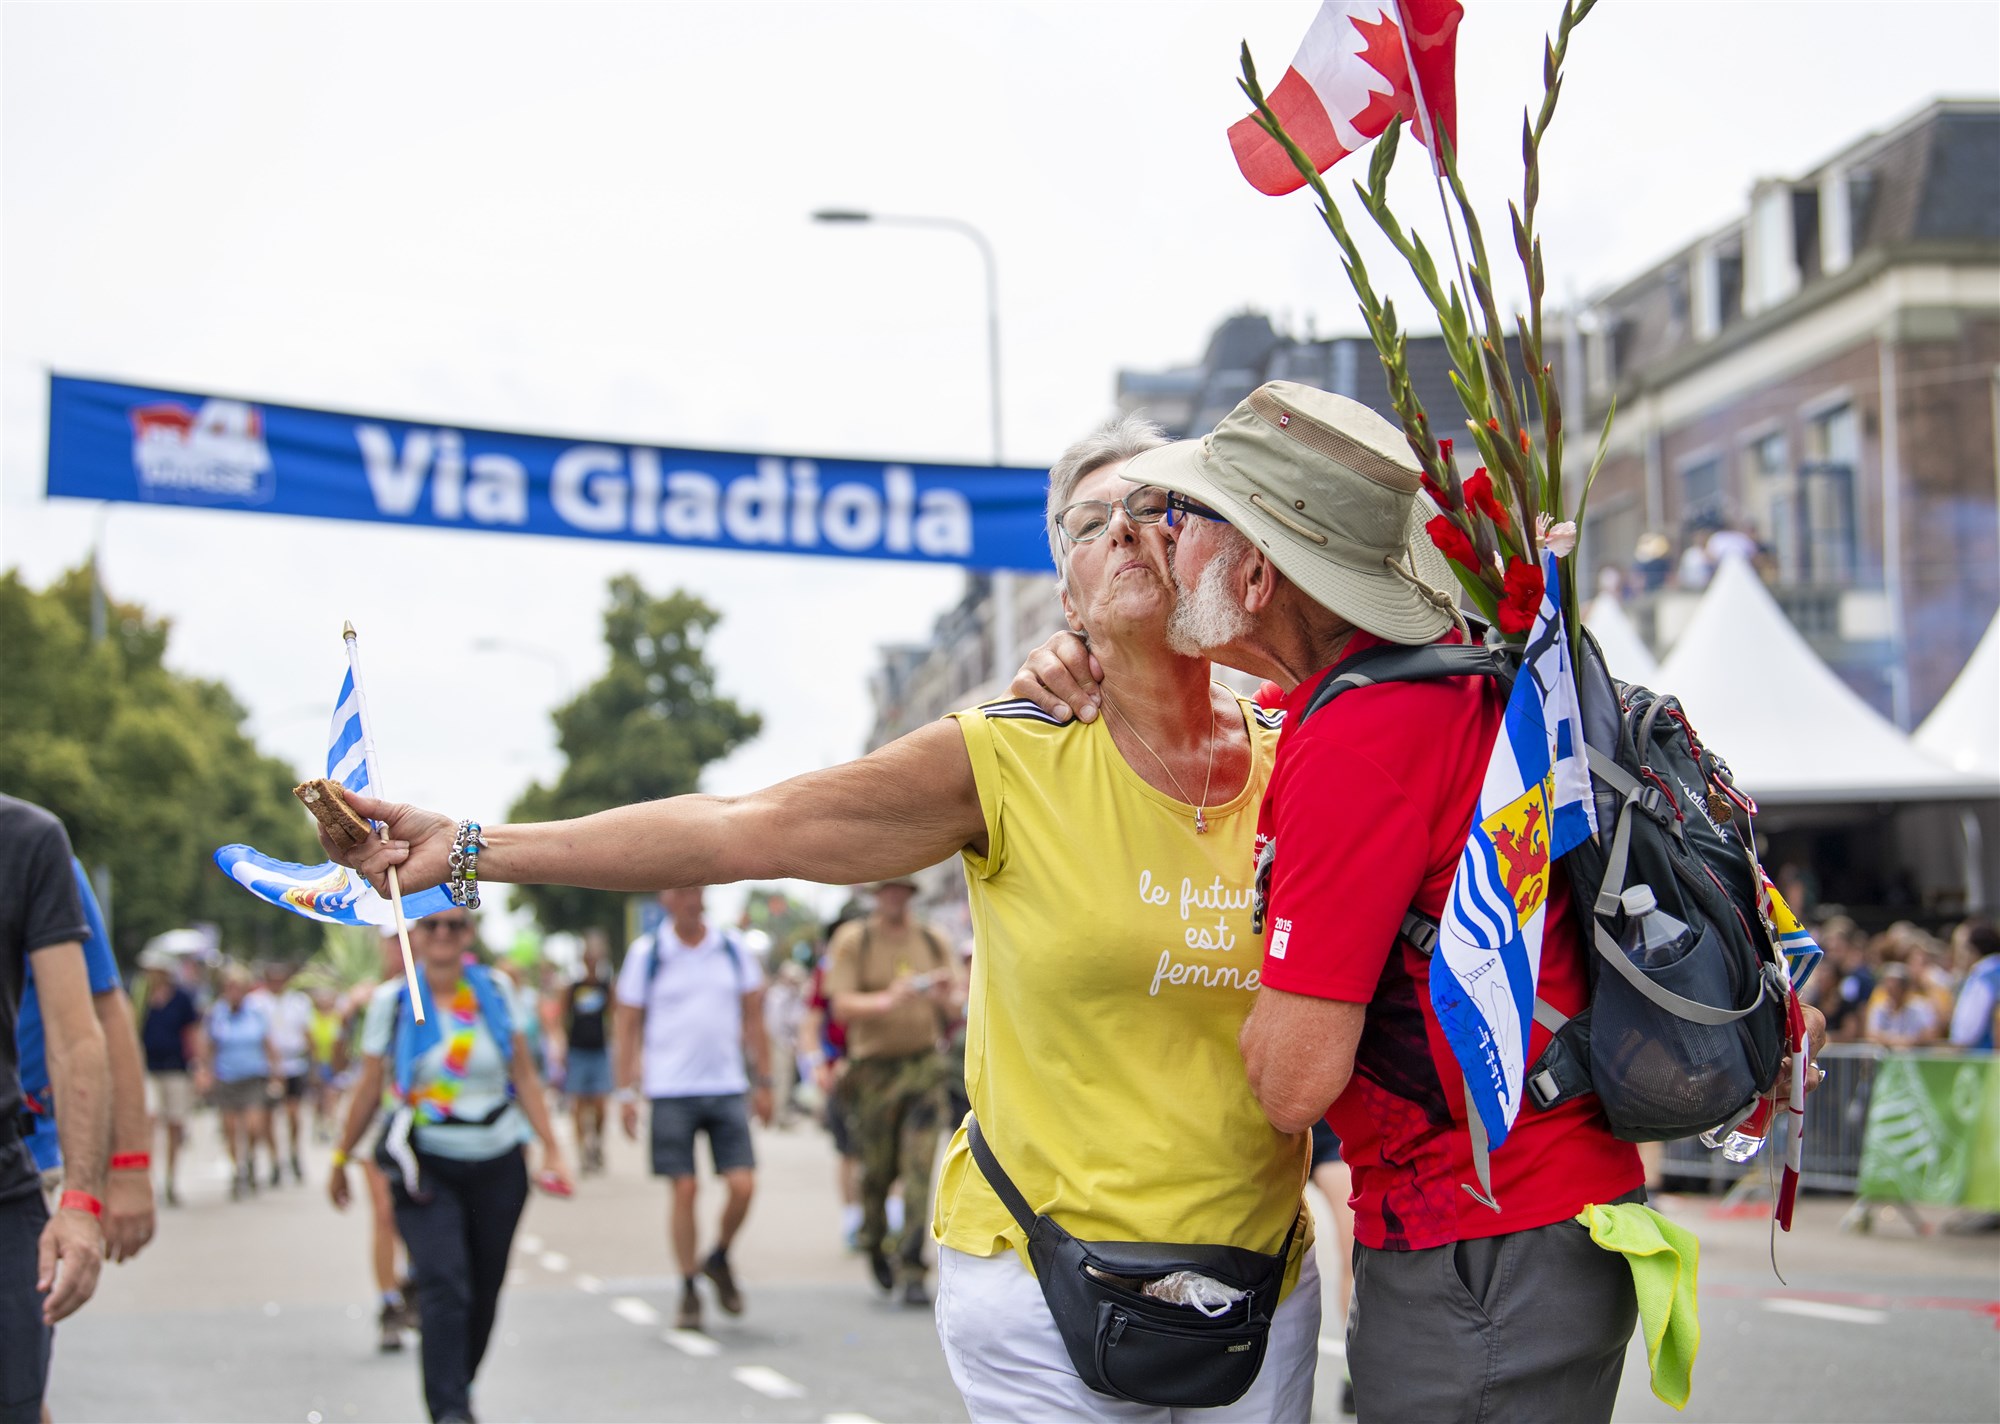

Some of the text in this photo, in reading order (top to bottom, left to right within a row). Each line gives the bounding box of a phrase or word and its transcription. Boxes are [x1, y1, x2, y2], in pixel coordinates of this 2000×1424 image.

[353, 423, 530, 526] Via
[549, 443, 974, 558] Gladiola
[1139, 869, 1171, 906] le
[1185, 916, 1236, 951] est
[1275, 917, 1293, 932] 2015
[1149, 950, 1262, 996] femme
